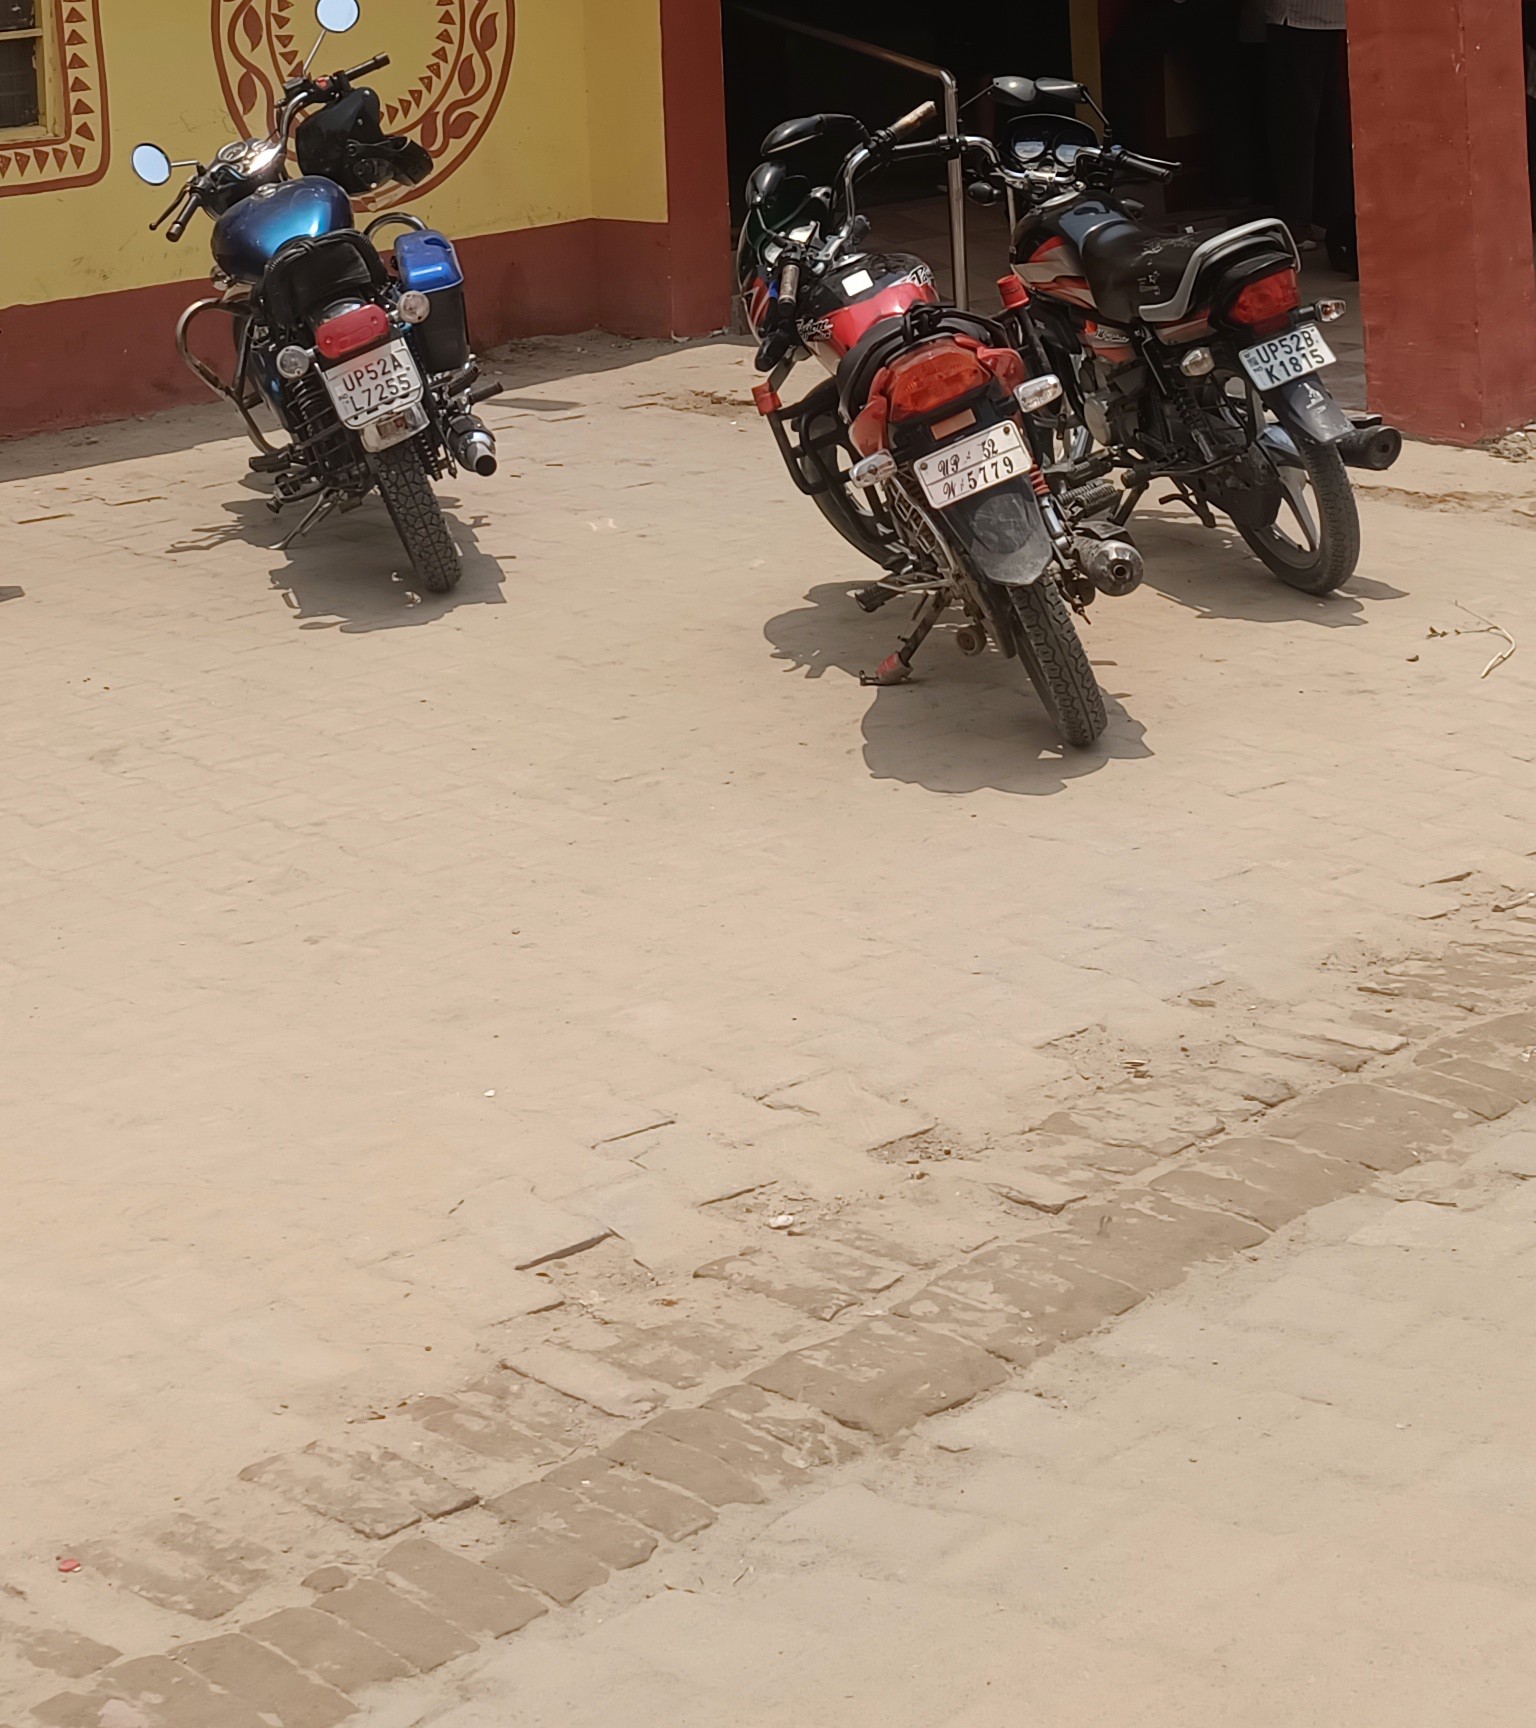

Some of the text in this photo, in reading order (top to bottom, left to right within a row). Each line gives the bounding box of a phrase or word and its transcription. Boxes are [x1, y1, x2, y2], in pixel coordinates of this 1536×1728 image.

[1256, 330, 1314, 364] UP52B
[342, 354, 403, 392] UP52A
[1265, 348, 1325, 384] K1815
[350, 374, 411, 412] L7255
[967, 456, 1014, 490] 5779
